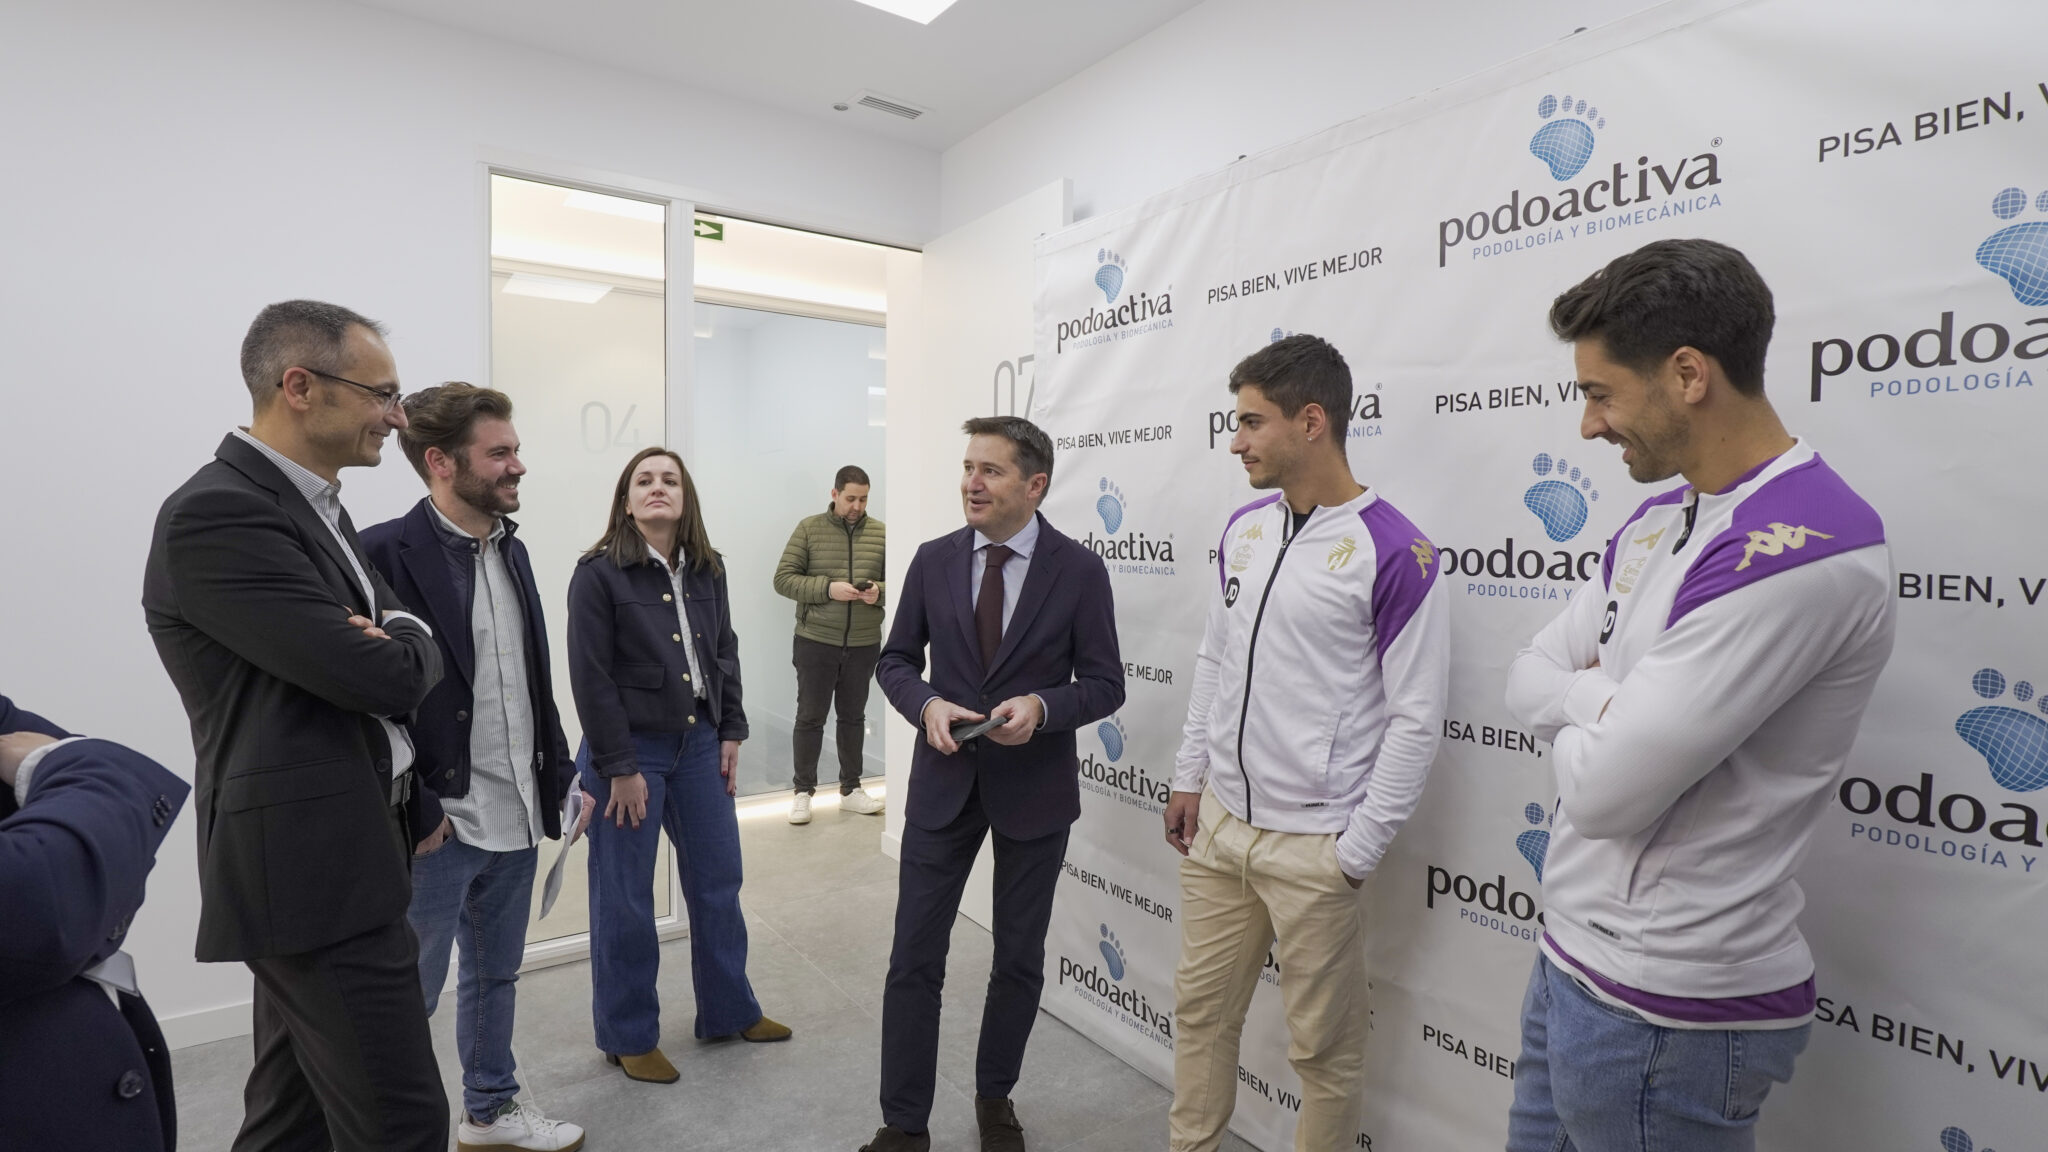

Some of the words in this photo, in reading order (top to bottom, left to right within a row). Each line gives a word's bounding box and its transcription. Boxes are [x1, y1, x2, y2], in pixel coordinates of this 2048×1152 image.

[1819, 122, 1902, 163] PISA
[1915, 91, 2025, 142] BIEN,
[1439, 153, 1722, 267] podoactiva
[1473, 227, 1564, 260] PODOLOGÍA
[1570, 225, 1580, 239] Y
[1586, 193, 1722, 235] BIOMECÁNICA
[1208, 284, 1238, 304] PISA
[1242, 273, 1280, 296] BIEN,
[1284, 262, 1319, 285] VIVE
[1323, 246, 1382, 277] MEJOR
[1058, 292, 1172, 354] podoactiva
[1436, 392, 1482, 414] PISA
[1489, 384, 1550, 407] BIEN,
[1557, 381, 1587, 402] VI
[1870, 366, 2033, 398] PODOLOGÍA
[1057, 436, 1076, 450] PISA
[1078, 432, 1106, 448] BIEN,
[1108, 429, 1131, 445] VIVE
[1134, 425, 1172, 442] MEJOR
[1468, 583, 1558, 600] PODOLOGÍA
[1564, 588, 1572, 600] Y
[1899, 573, 2004, 608] BIEN,
[1136, 664, 1173, 685] MEJOR
[1482, 726, 1542, 758] BIEN,
[1852, 823, 2007, 868] PODOLOGÍA
[2021, 855, 2036, 872] Y
[1061, 860, 1080, 880] PISA
[1081, 870, 1108, 894] BIEN,
[1110, 882, 1132, 904] VIVE
[1135, 894, 1173, 923] MEJOR
[1060, 956, 1173, 1039] podoactiva
[1424, 1024, 1468, 1060] PISA
[1872, 1013, 1975, 1073] BIEN,
[1239, 1066, 1273, 1102] BIEN,
